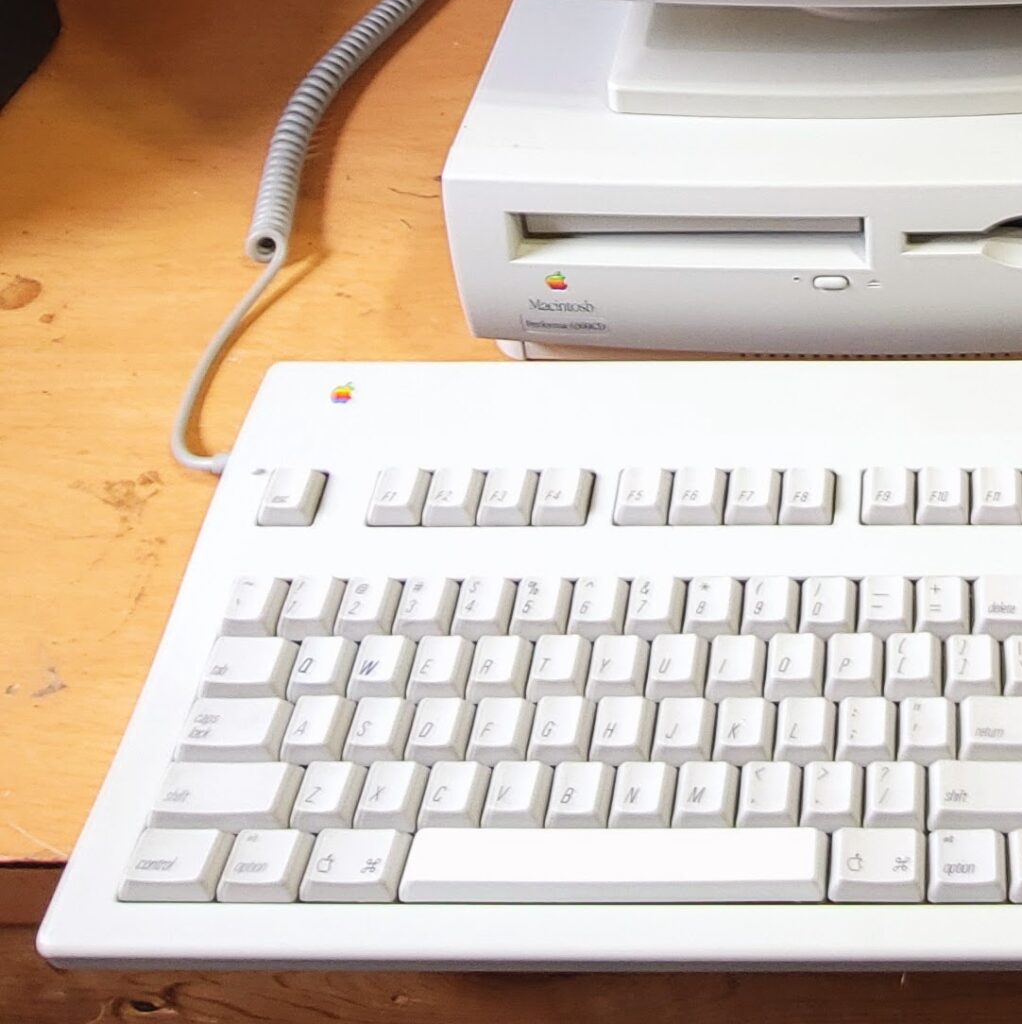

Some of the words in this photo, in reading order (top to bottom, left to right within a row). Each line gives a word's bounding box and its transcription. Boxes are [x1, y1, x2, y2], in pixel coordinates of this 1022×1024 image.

[528, 298, 594, 313] Macintosh
[381, 490, 397, 502] F1
[434, 490, 452, 502] F2
[489, 490, 507, 502] F3
[544, 490, 561, 501] F4
[627, 490, 643, 501] F5
[681, 490, 698, 501] F6
[738, 491, 754, 502] F7
[792, 492, 809, 502] F8
[875, 490, 891, 502] F9
[929, 491, 949, 502] F10
[985, 491, 1001, 502] F11
[988, 602, 1016, 614] delete
[298, 658, 315, 674] Q
[359, 660, 380, 676] W
[419, 659, 434, 674] E
[539, 658, 551, 672] T
[599, 658, 610, 672] Y
[658, 658, 672, 674] U
[778, 657, 791, 673] O
[838, 658, 850, 673] P
[295, 721, 308, 736] A
[356, 721, 372, 736] S
[418, 721, 434, 738] D
[480, 721, 494, 736] F
[541, 721, 556, 738] G
[603, 722, 617, 738] H
[665, 722, 677, 739] J
[728, 722, 740, 739] K
[789, 723, 799, 739] L
[975, 726, 1005, 737] return
[163, 789, 190, 803] shift
[305, 786, 322, 803] Z
[369, 786, 385, 802] X
[432, 785, 448, 802] C
[496, 785, 511, 802] V
[560, 787, 575, 804] B
[625, 787, 639, 804] N
[688, 786, 706, 803] M
[944, 790, 969, 803] shift
[135, 856, 178, 871] control
[234, 862, 268, 874] option
[943, 862, 975, 875] option
